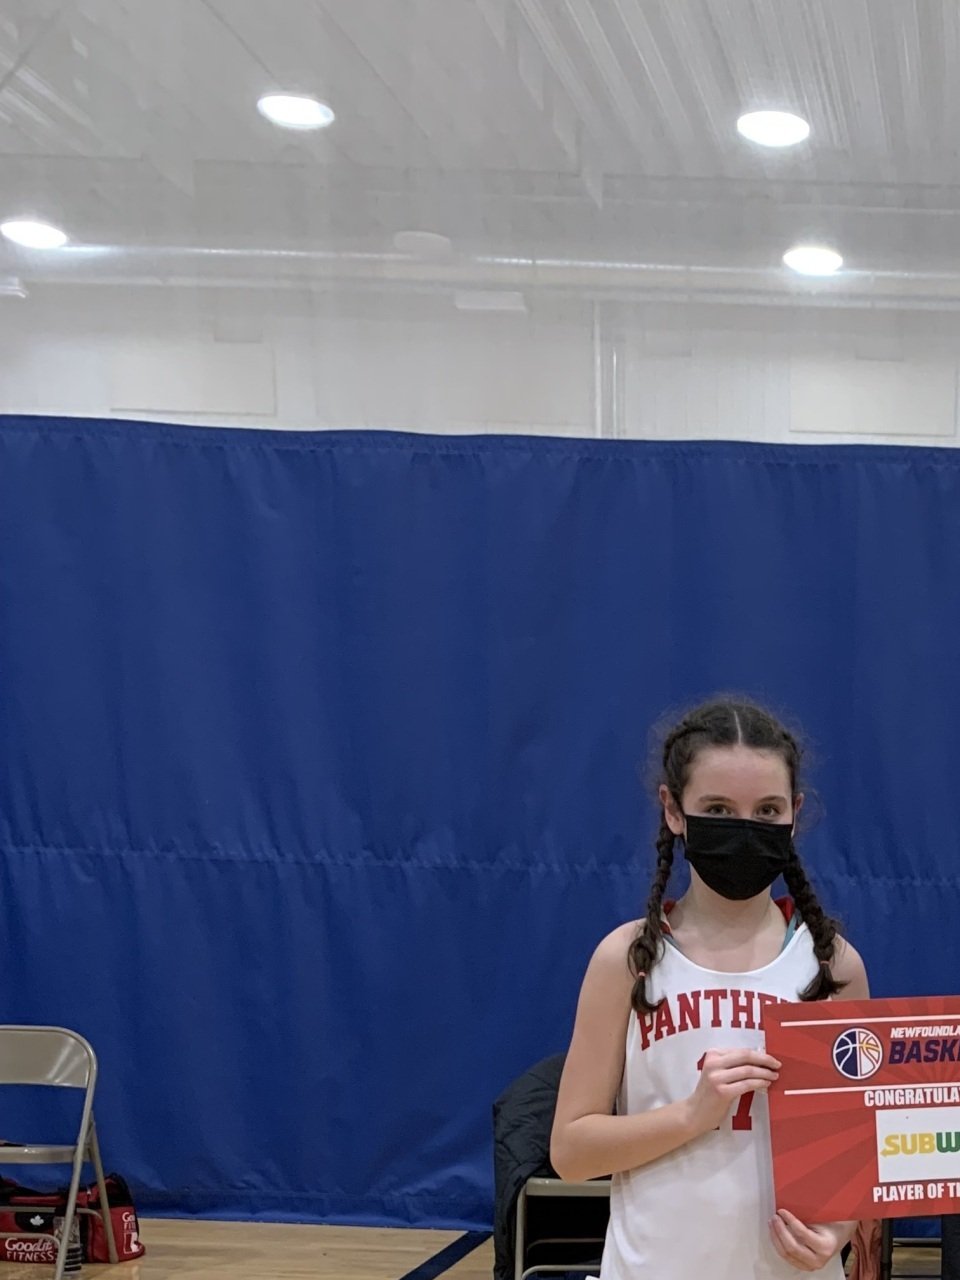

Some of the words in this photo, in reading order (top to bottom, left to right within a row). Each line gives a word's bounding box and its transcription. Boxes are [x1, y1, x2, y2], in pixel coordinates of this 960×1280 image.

[873, 1183, 925, 1203] PLAYER
[927, 1182, 945, 1199] OF
[6, 1250, 55, 1262] FITNESS
